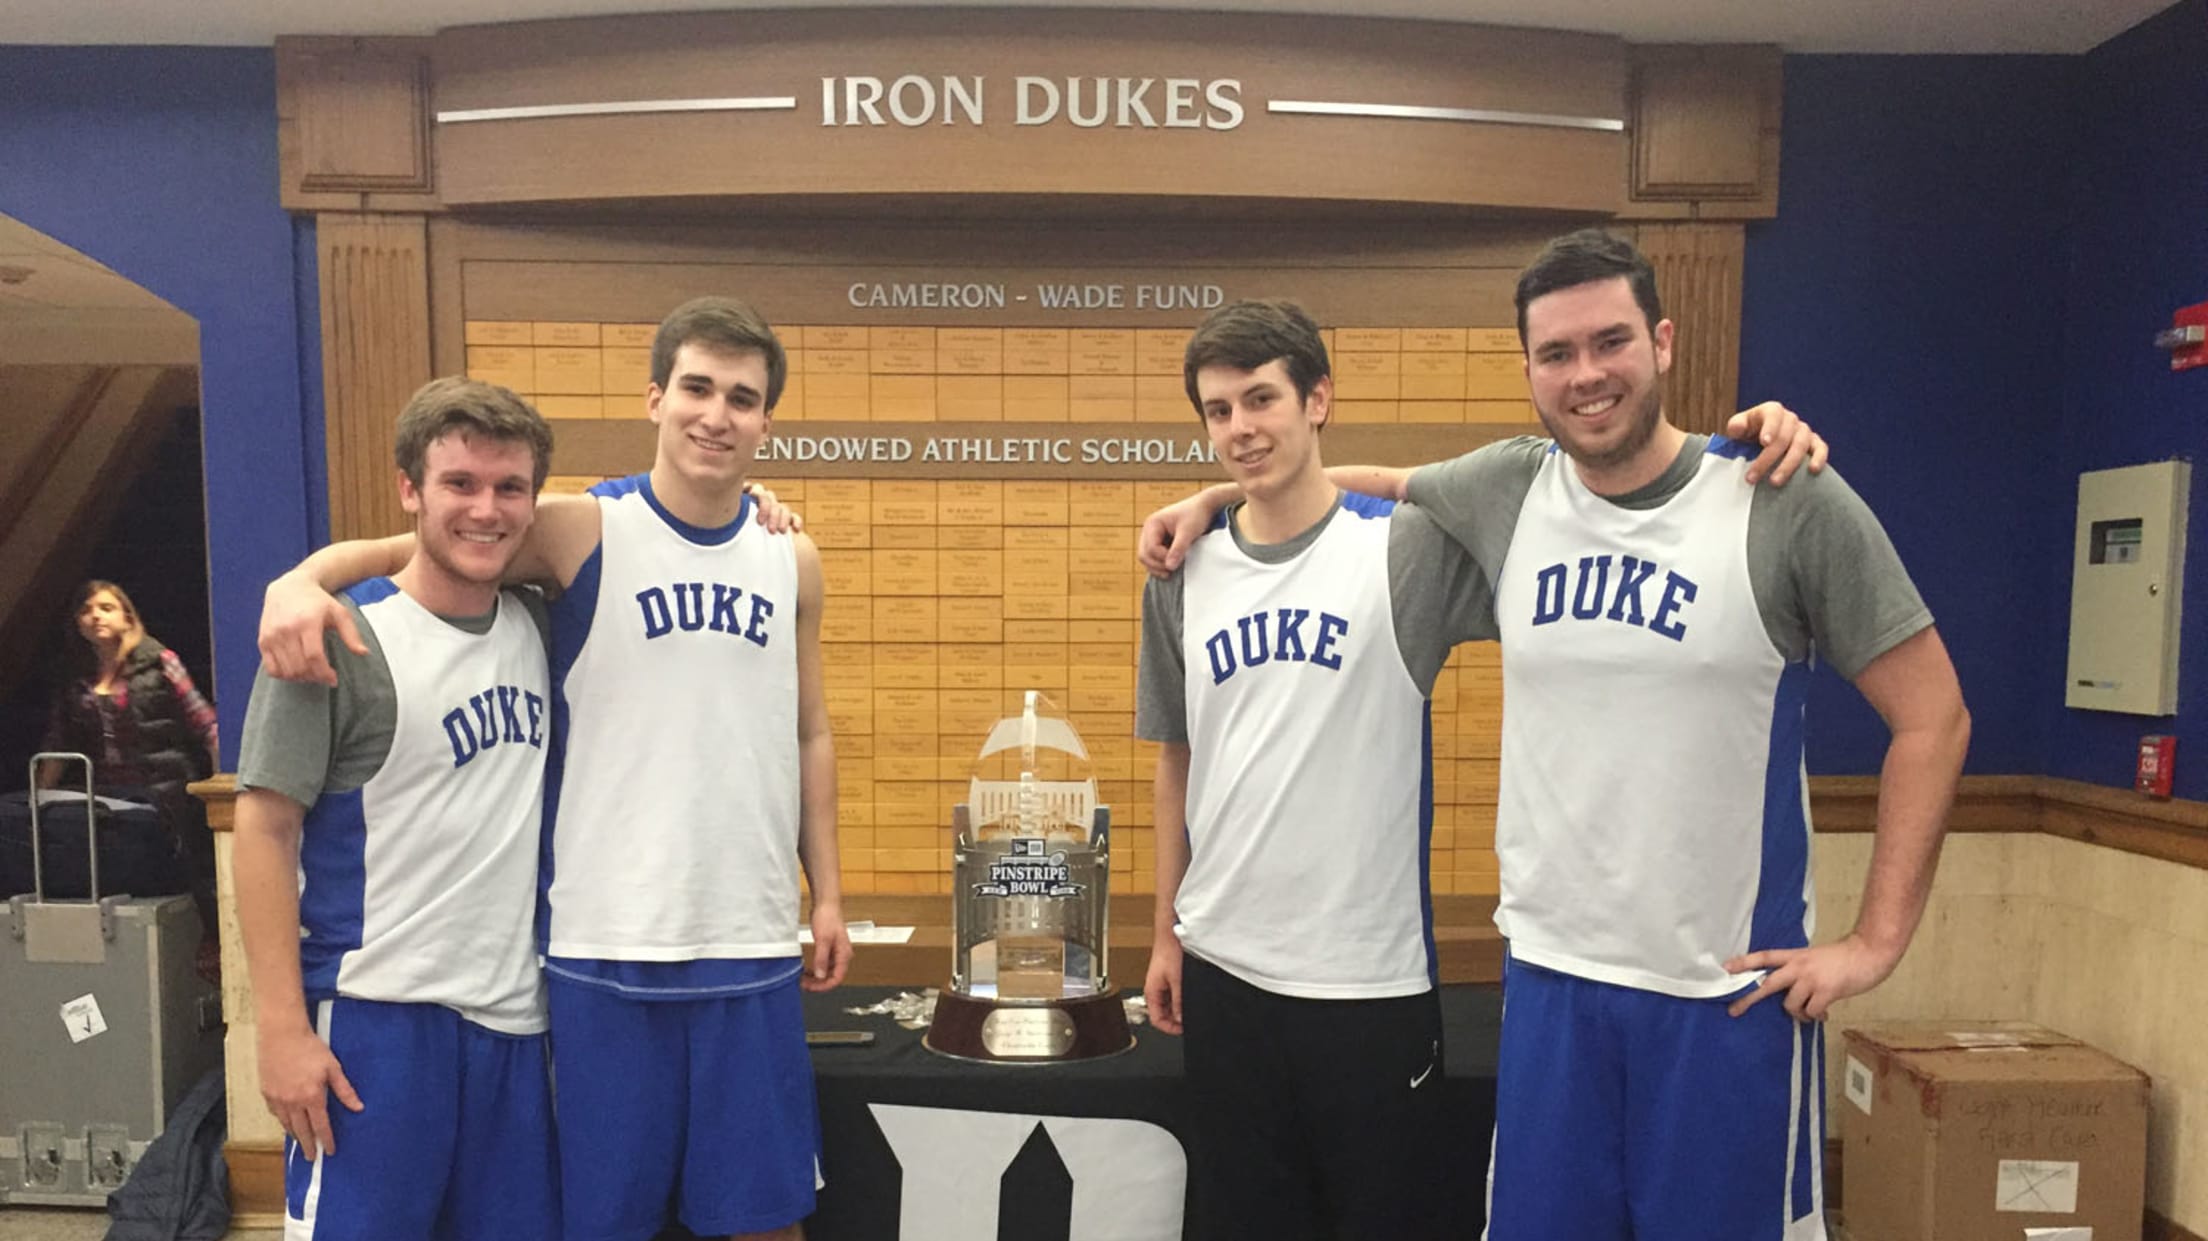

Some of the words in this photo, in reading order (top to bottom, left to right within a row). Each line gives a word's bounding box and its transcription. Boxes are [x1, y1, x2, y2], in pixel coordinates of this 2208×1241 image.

[820, 74, 985, 128] IRON
[1014, 76, 1245, 131] DUKES
[847, 282, 1005, 309] CAMERON
[1038, 285, 1121, 309] WADE
[1136, 285, 1226, 310] FUND
[753, 436, 913, 462] ENDOWED
[921, 438, 1072, 463] ATHLETIC
[635, 582, 774, 648] DUKE
[1532, 555, 1699, 643] DUKE
[1205, 608, 1349, 687] DUKE
[442, 685, 544, 769] DUKE
[991, 865, 1068, 881] PINSTRIPE
[1009, 881, 1049, 894] BOWL
